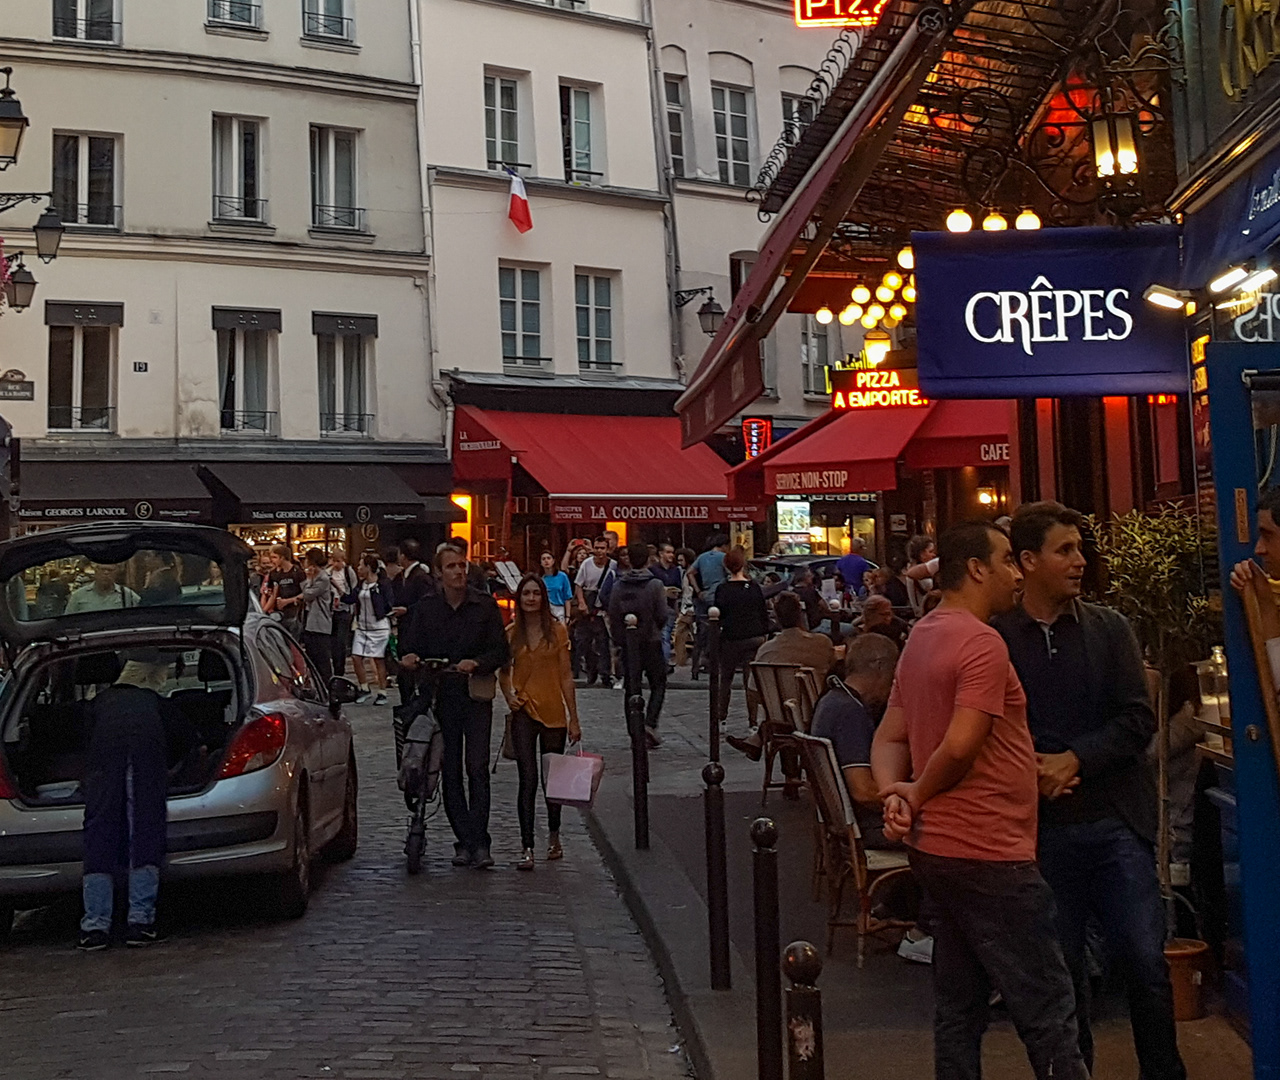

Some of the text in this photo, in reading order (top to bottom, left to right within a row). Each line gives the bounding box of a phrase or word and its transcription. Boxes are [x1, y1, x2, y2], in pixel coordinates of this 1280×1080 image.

[965, 275, 1133, 355] CRÊPES
[135, 362, 146, 372] 19
[856, 371, 900, 388] PIZZA
[834, 391, 846, 408] A
[775, 470, 848, 490] SERVICE NON-STOP
[45, 507, 84, 517] GEORGES
[86, 507, 128, 516] LARNICOL
[275, 510, 307, 519] GEORGES
[309, 510, 343, 519] LARNICOL
[590, 506, 607, 519] LA
[612, 506, 709, 519] COCHONNAILLE
